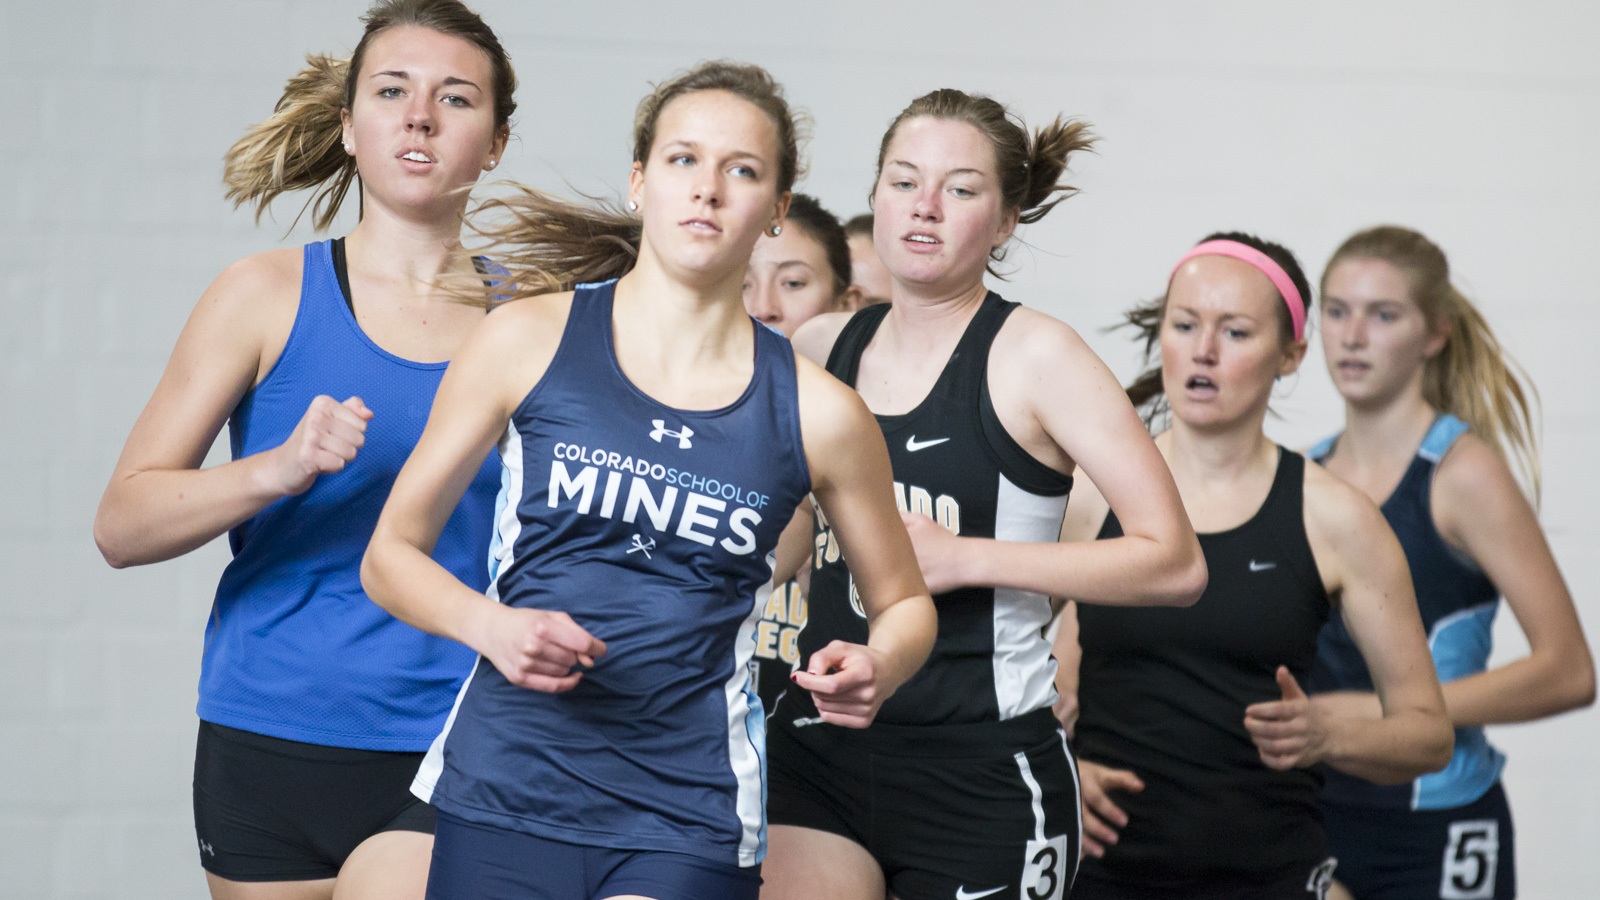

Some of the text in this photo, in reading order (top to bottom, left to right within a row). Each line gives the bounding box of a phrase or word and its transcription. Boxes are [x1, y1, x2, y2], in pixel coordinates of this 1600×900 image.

[547, 460, 763, 556] MINES
[1026, 846, 1058, 900] 3
[1452, 830, 1488, 892] 5
